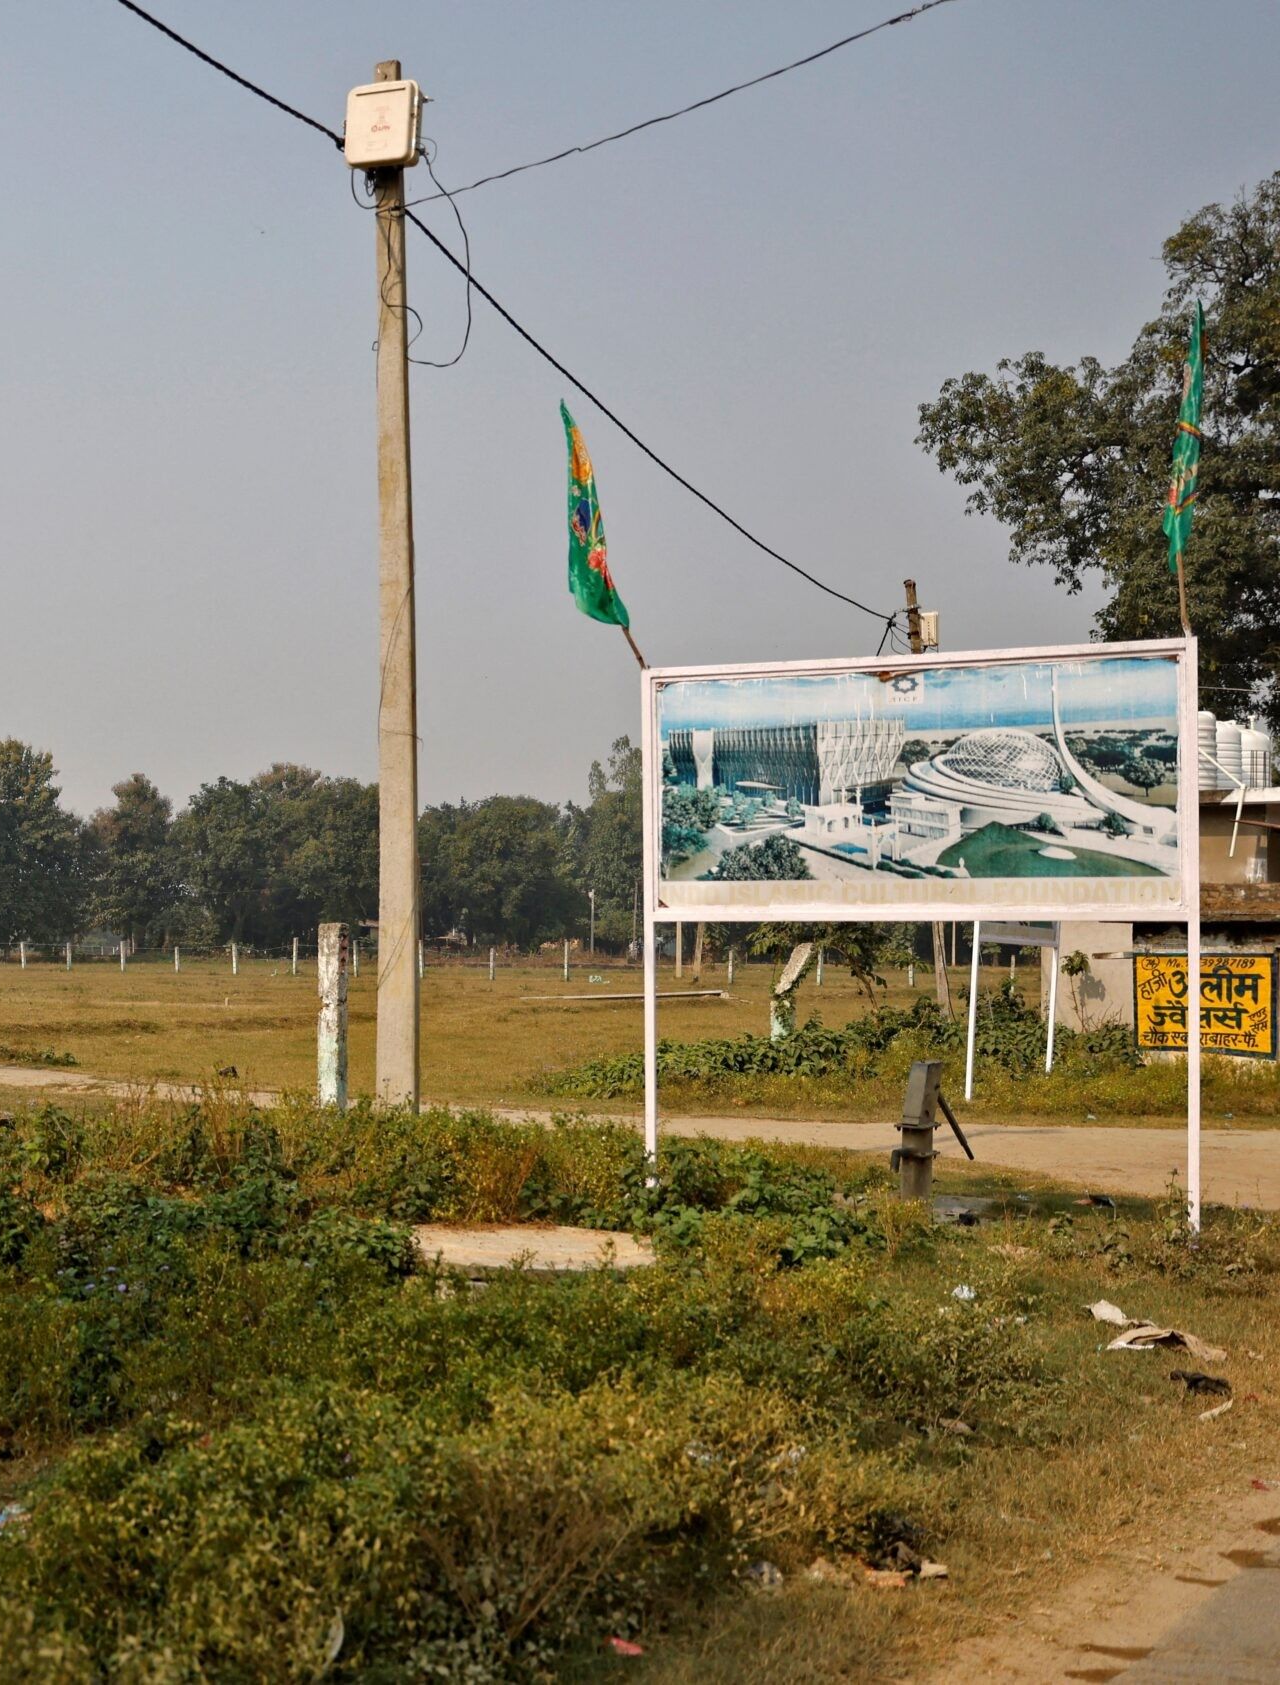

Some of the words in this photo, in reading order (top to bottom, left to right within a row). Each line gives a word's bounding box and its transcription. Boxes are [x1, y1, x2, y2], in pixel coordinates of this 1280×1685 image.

[730, 885, 830, 905] ISLAMIC
[842, 882, 977, 904] CULTURAL
[993, 880, 1181, 904] FOUNDATION
[1142, 1027, 1169, 1044] चौक
